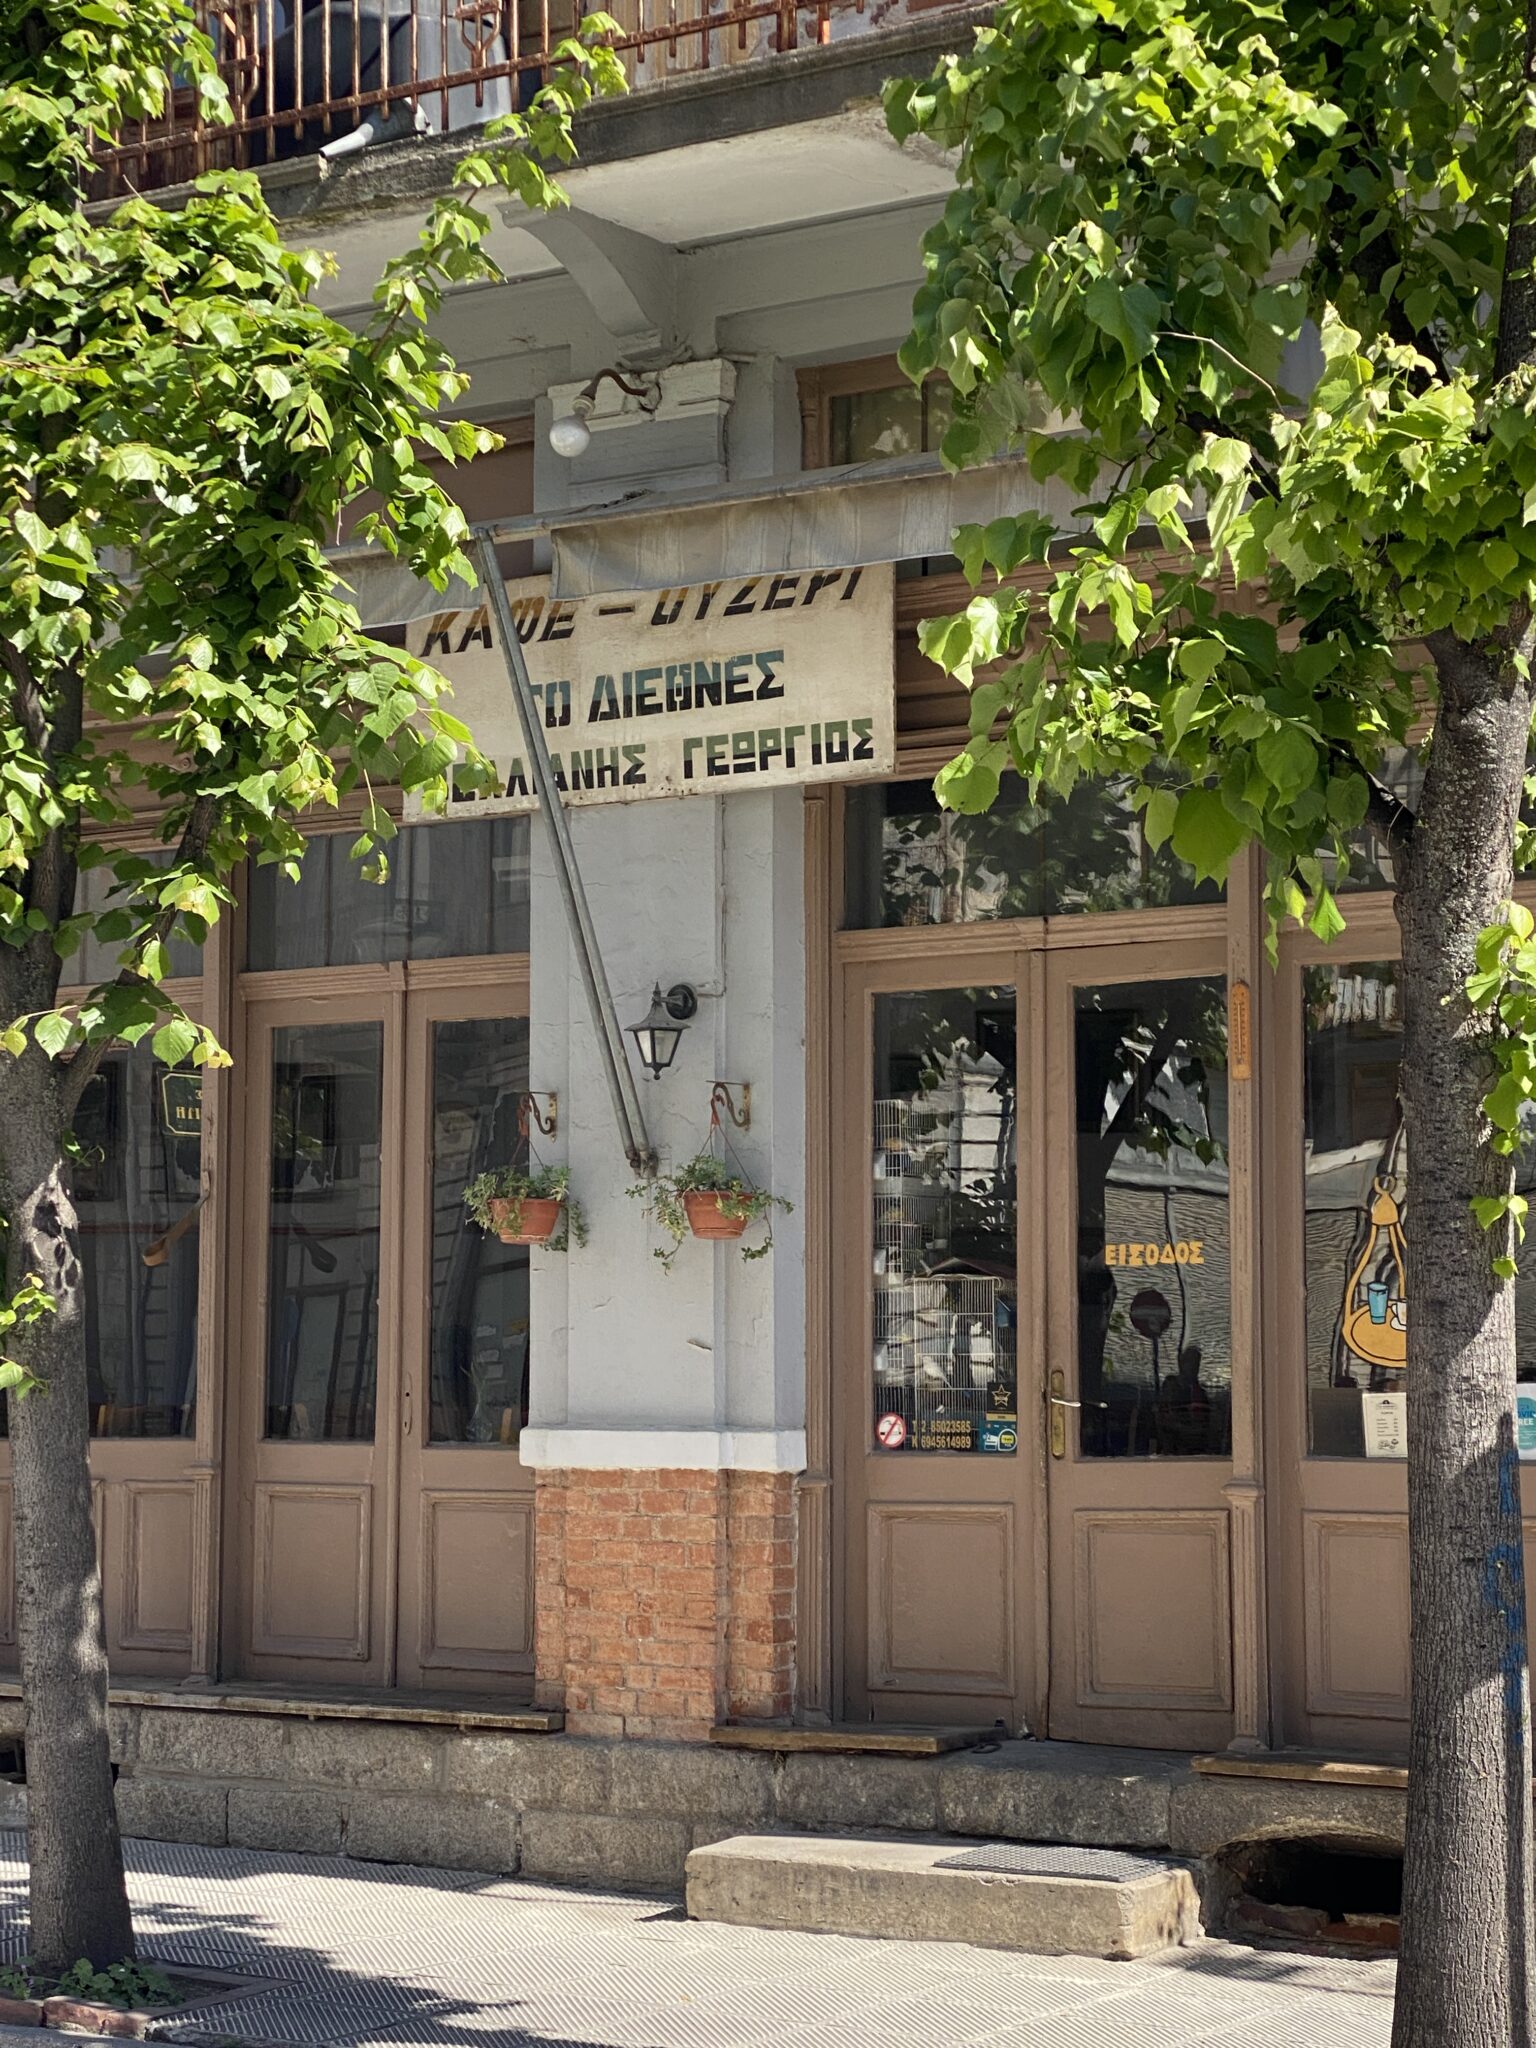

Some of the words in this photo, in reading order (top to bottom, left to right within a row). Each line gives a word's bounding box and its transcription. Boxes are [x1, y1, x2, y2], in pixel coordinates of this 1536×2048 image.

[588, 649, 785, 723] ΔΙΕΘΝΕΣ
[683, 717, 874, 779] ΓΕΩΡΓΙΟΣ
[1105, 1241, 1205, 1266] ΕΙΣΟΔΟΣ
